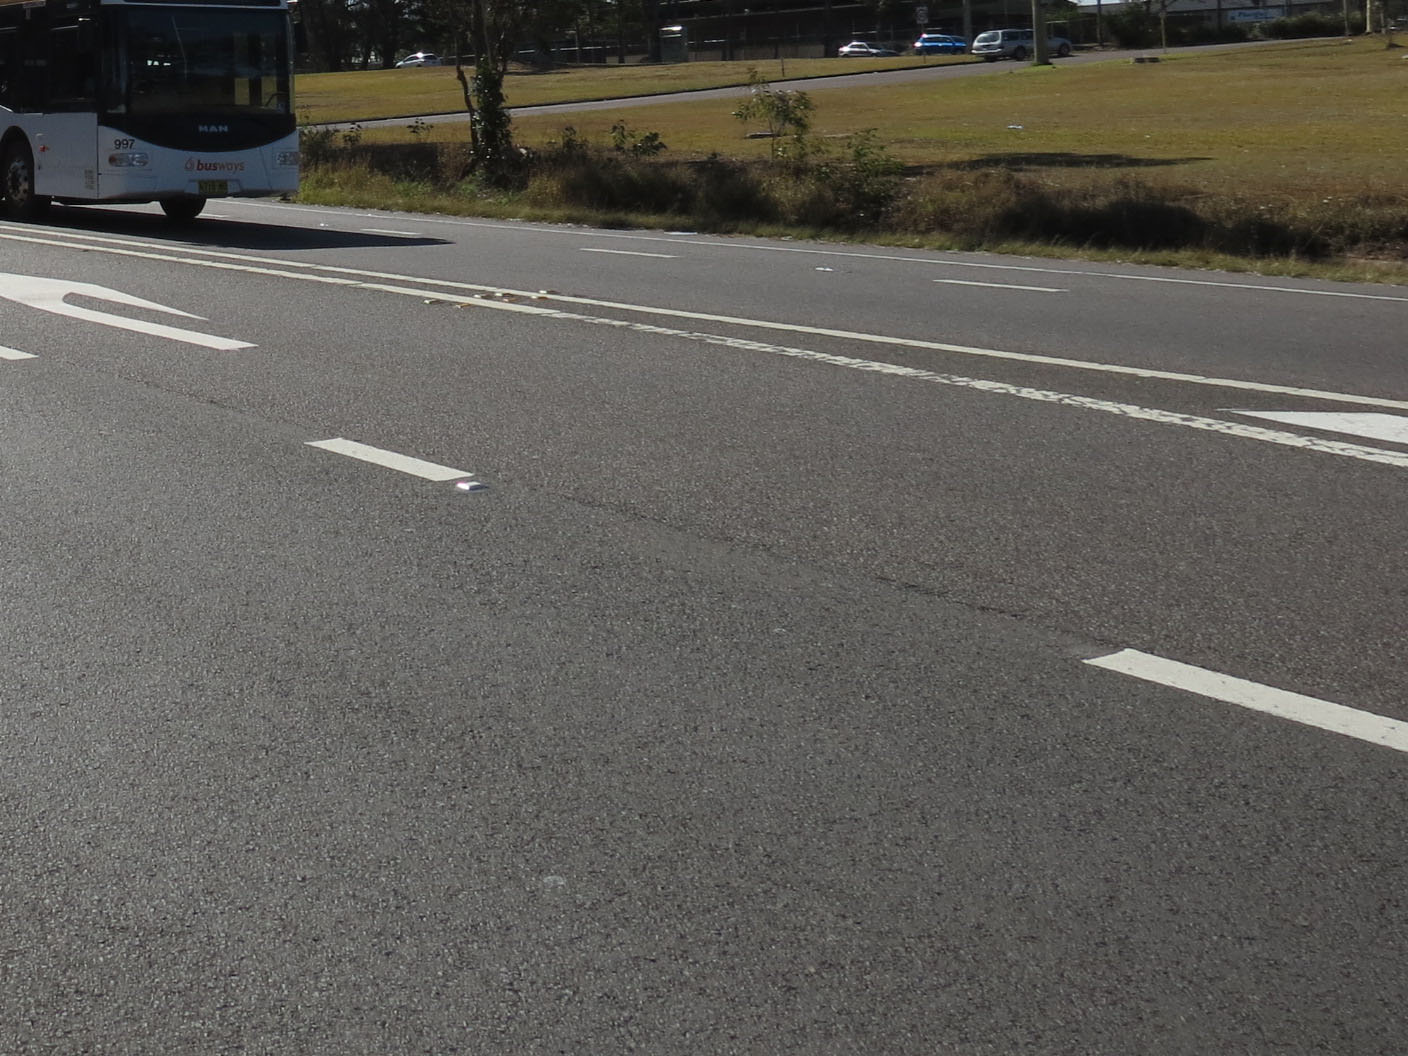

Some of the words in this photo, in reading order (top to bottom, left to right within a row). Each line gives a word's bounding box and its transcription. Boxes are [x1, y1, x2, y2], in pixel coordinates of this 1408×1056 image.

[198, 124, 229, 133] MAN
[113, 139, 135, 150] 997
[196, 159, 245, 174] busways
